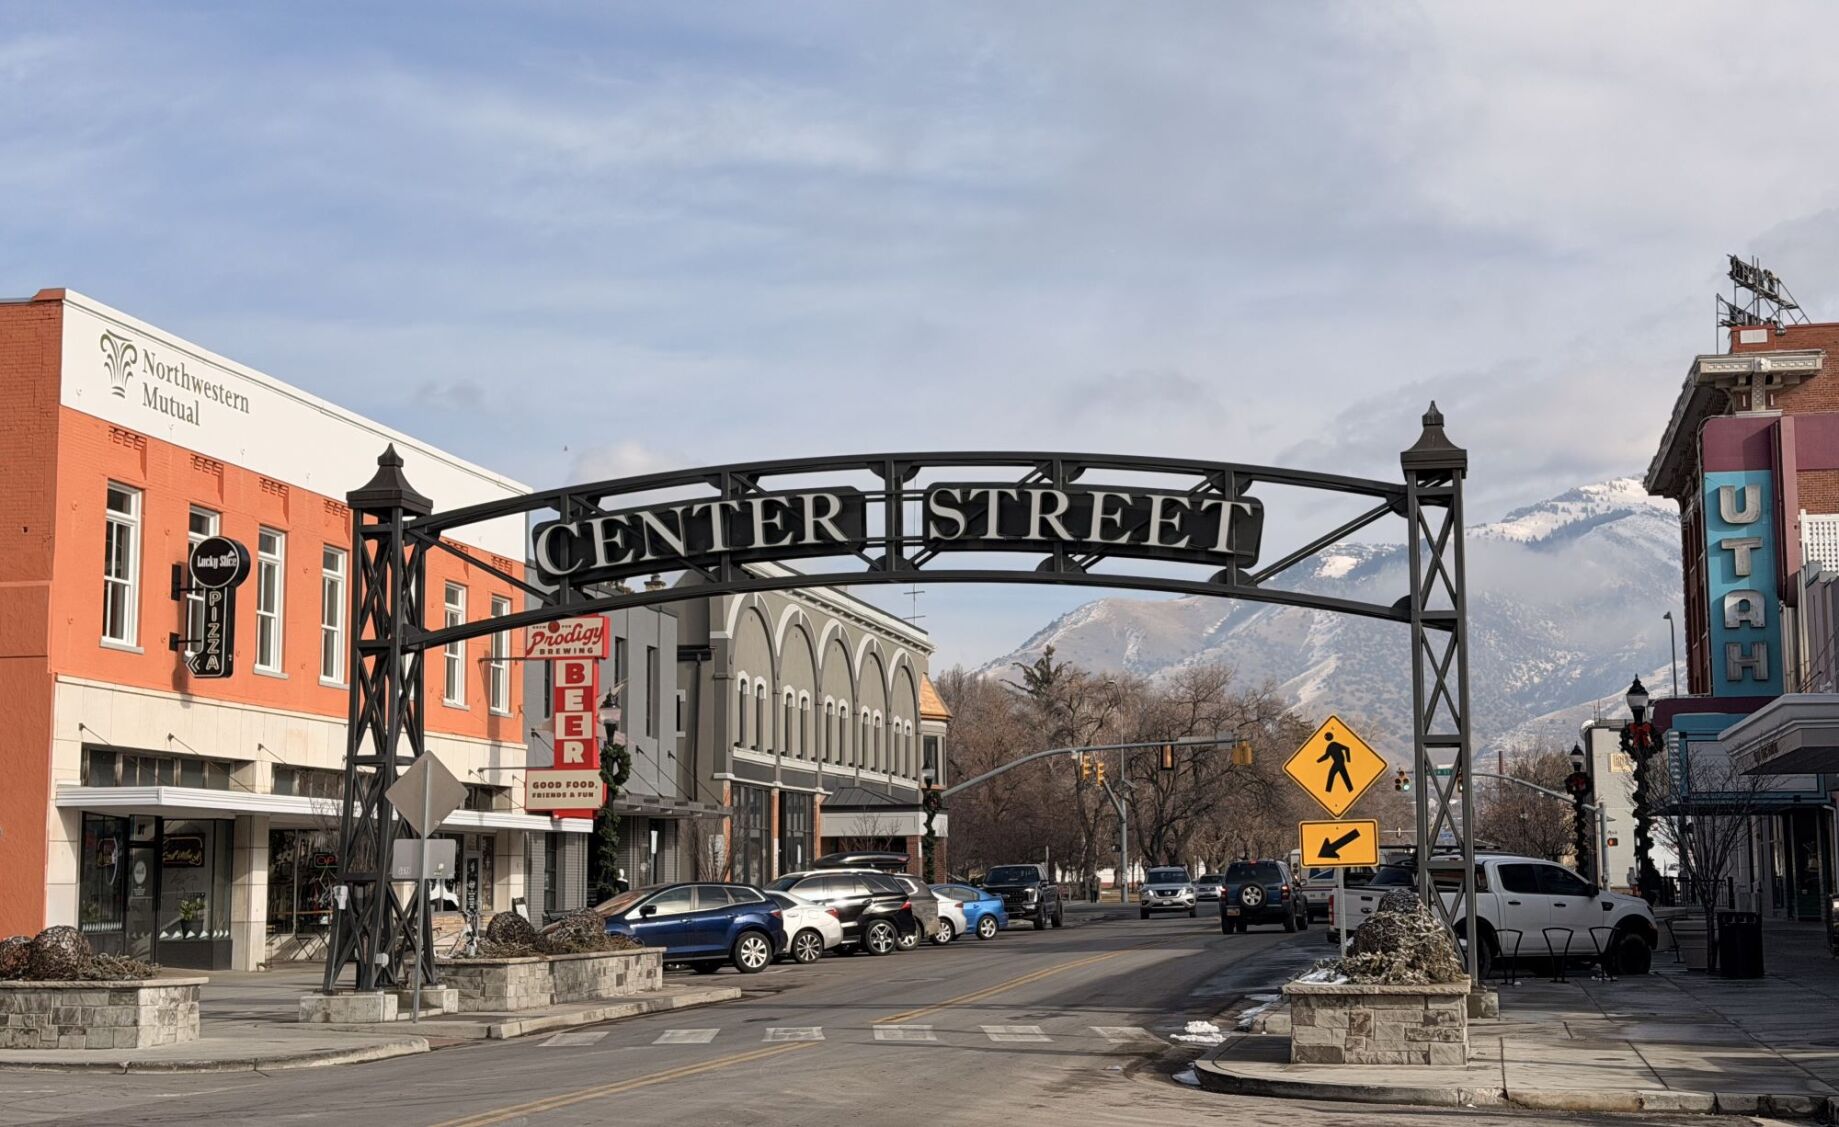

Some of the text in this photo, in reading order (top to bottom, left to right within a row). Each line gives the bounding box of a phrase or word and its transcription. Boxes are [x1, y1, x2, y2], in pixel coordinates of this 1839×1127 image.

[142, 347, 250, 414] Northwestern
[142, 381, 201, 426] Mutual
[535, 487, 1254, 577] CENTER STREET
[197, 554, 237, 569] Lucky Slice
[1719, 485, 1769, 681] UTAH
[205, 590, 222, 671] PIZZA
[525, 622, 604, 656] Prodigy
[539, 646, 594, 655] BREWING
[562, 662, 586, 764] BEER
[532, 780, 598, 789] GOOD FOOD,
